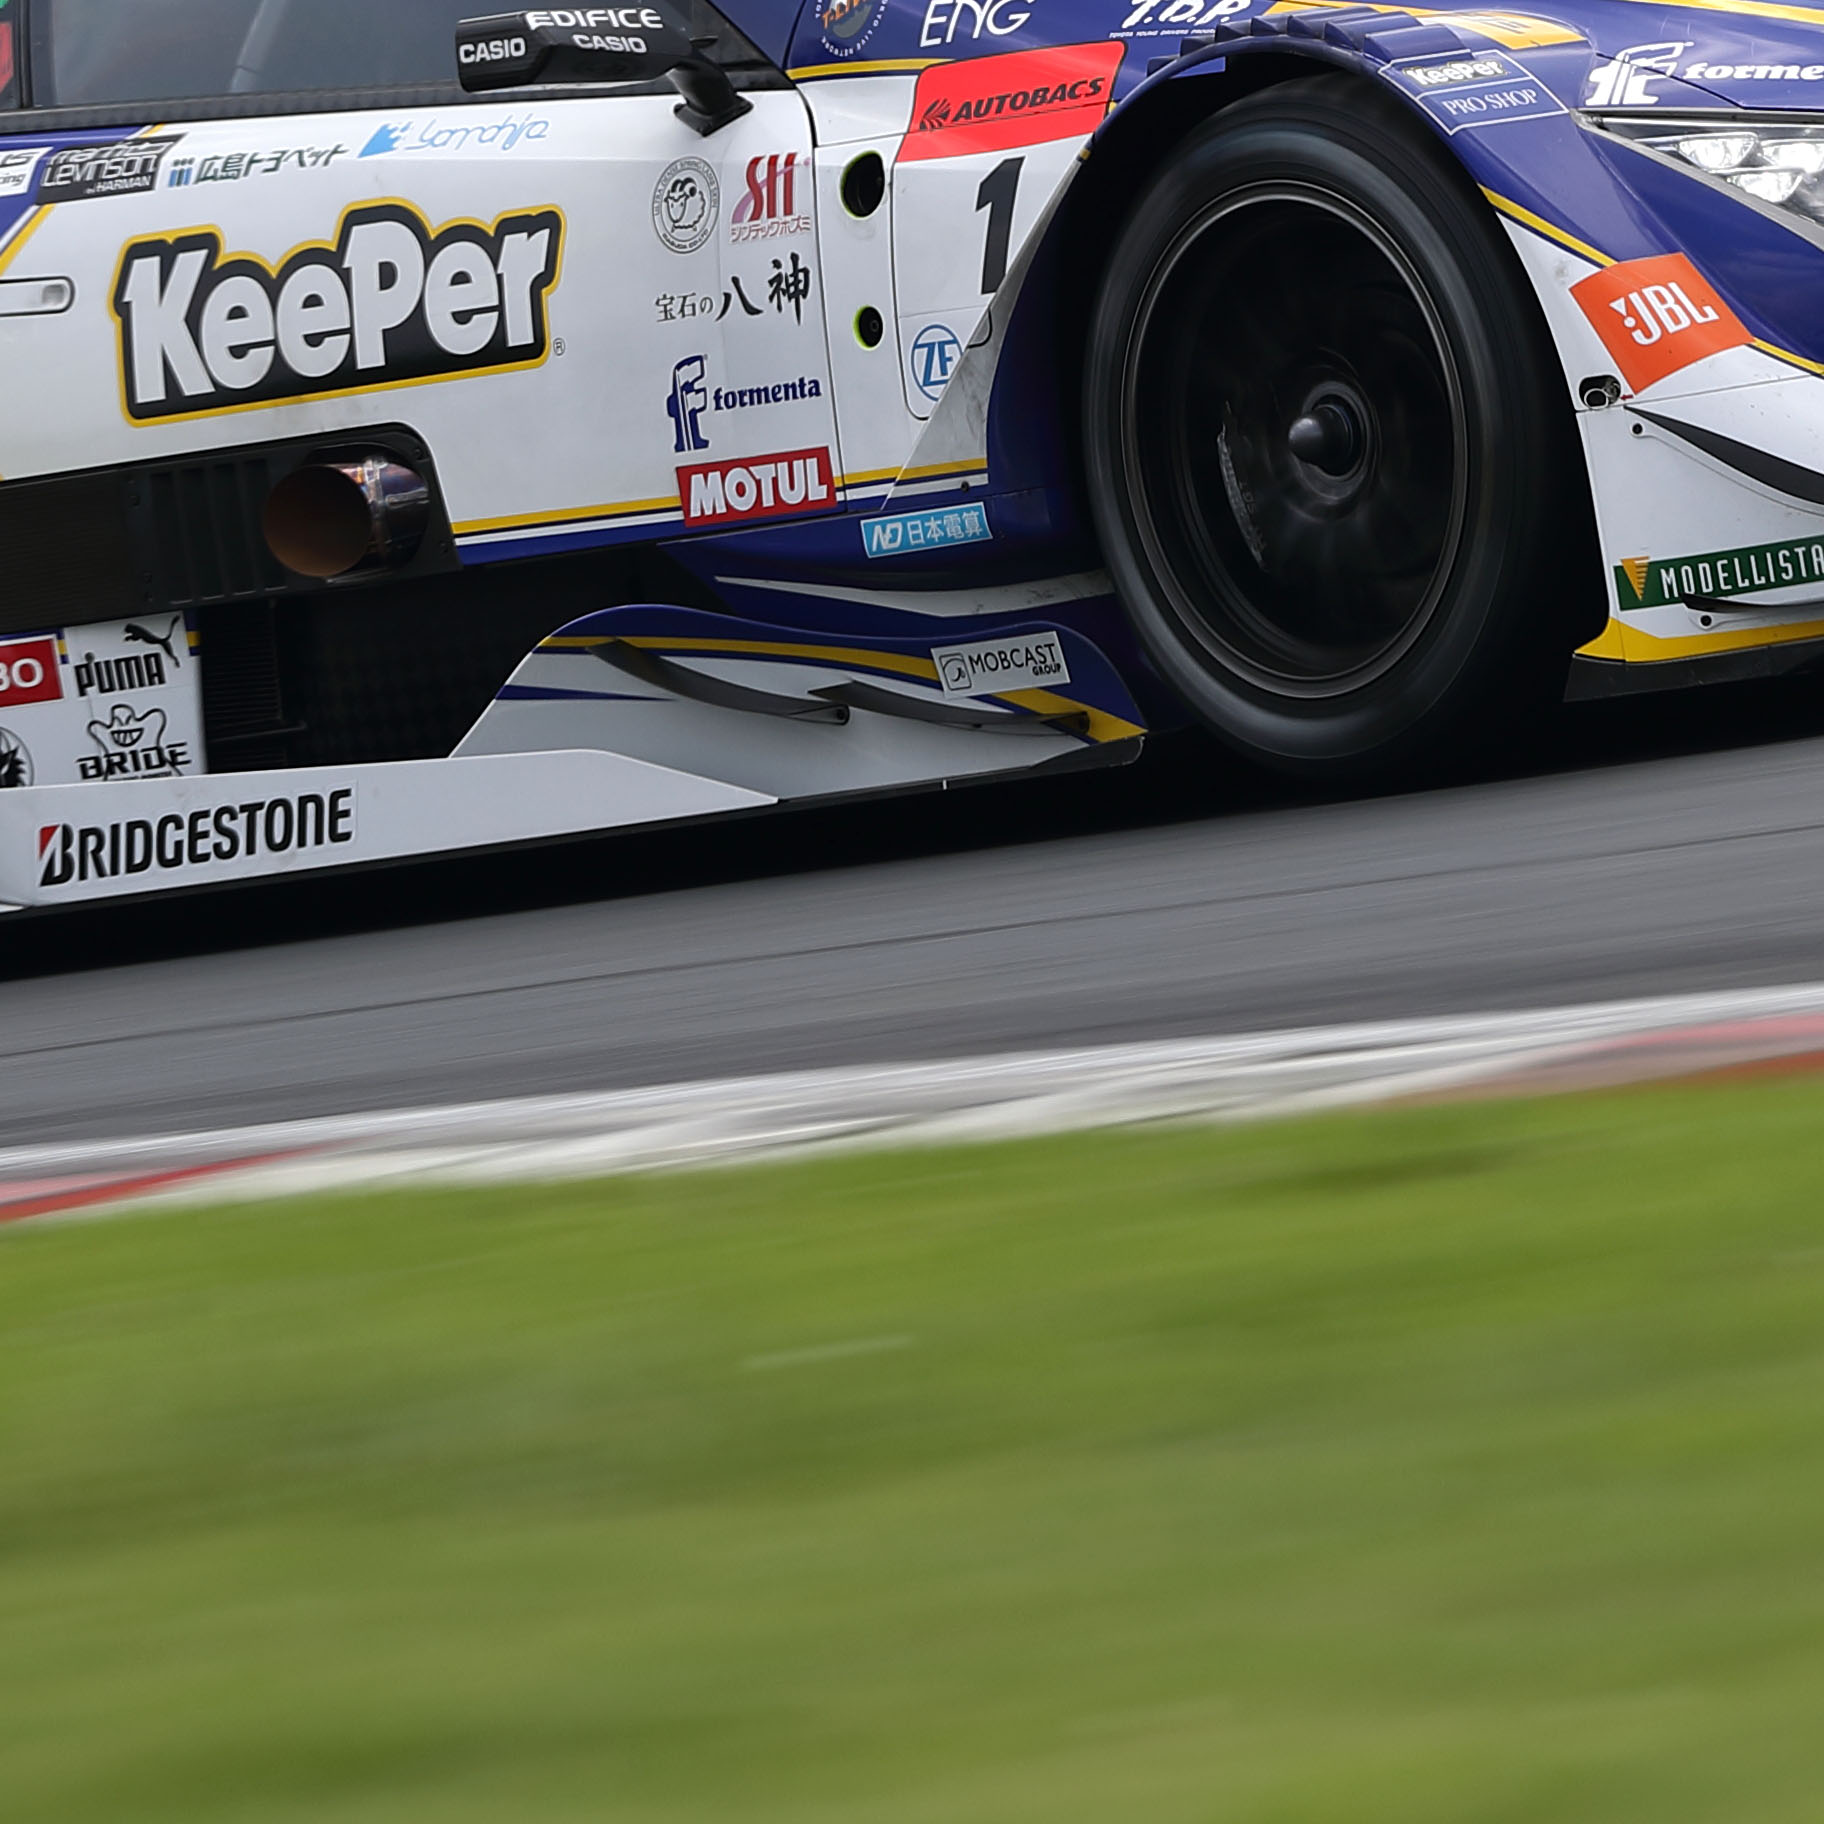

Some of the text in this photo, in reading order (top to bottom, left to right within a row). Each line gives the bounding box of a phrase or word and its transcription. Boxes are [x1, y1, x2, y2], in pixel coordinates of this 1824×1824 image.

[526, 7, 664, 31] EDIFICE
[460, 37, 527, 64] CASIO
[572, 33, 647, 54] CASIO
[1406, 61, 1503, 86] KeePer
[953, 77, 1105, 122] AUTOBACS
[1441, 89, 1537, 116] PRO SHOP
[194, 143, 349, 185] 広島トヨペット
[95, 175, 152, 193] HARMAN
[976, 157, 1026, 295] 1
[655, 252, 811, 325] 宝石の八神
[119, 216, 554, 406] KeePer
[689, 457, 828, 518] MOTUL
[74, 652, 167, 697] PUMA
[968, 643, 1055, 674] MOBCAST
[1032, 662, 1062, 676] GROUP
[75, 742, 192, 780] BRIDE
[39, 787, 353, 887] BRIDGESTONE
